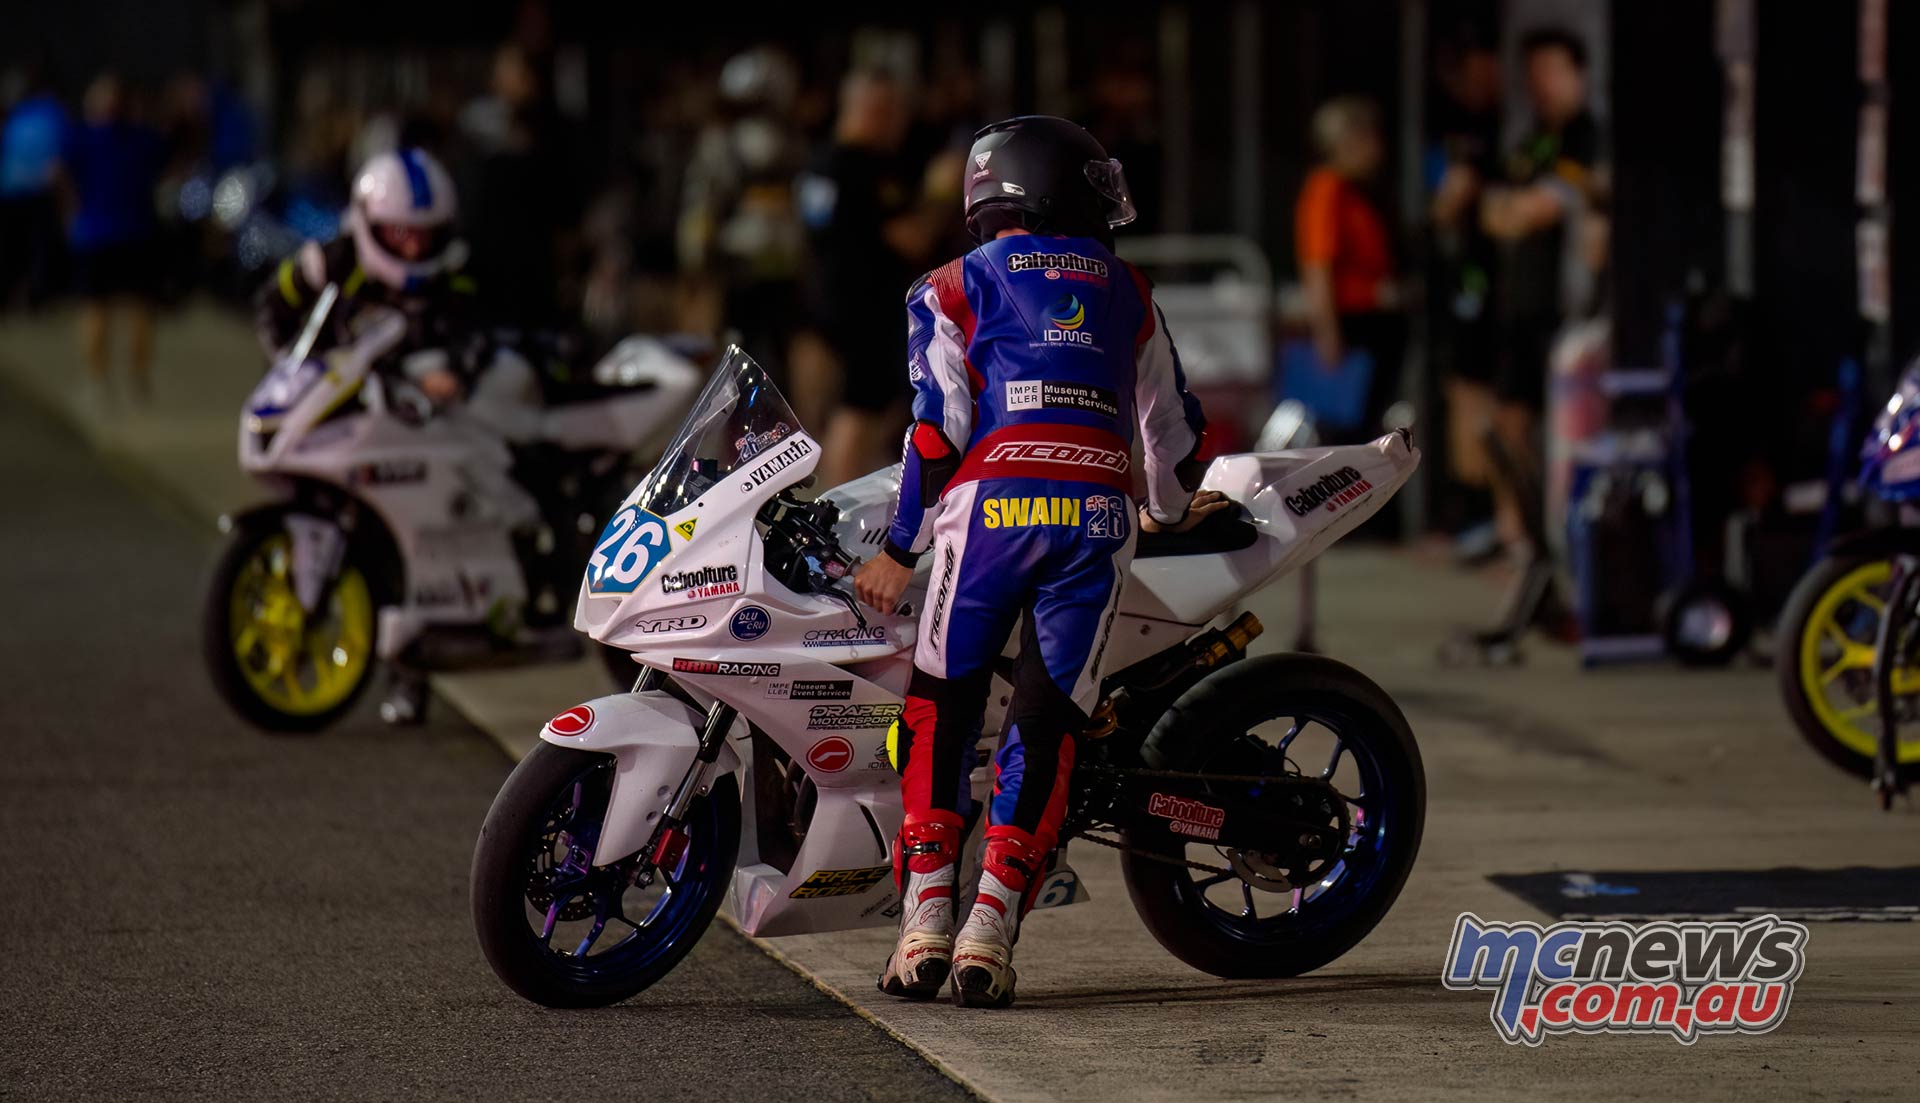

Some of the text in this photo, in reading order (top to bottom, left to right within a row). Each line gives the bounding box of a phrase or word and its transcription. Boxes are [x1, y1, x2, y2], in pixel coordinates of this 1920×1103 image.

[1008, 252, 1108, 278] Caboolture
[1043, 329, 1093, 345] IDMG
[1010, 385, 1038, 395] IMPE
[1044, 385, 1099, 399] Museum &
[1010, 395, 1038, 405] LLER
[1044, 394, 1118, 415] Event Services
[749, 439, 813, 486] YAMAHA
[1334, 480, 1373, 506] YAMAHA
[983, 494, 1125, 539] SWAIN 26
[587, 508, 664, 587] 26
[661, 565, 737, 593] Caboolture
[697, 582, 740, 598] YAMAHA
[636, 614, 707, 633] YRD
[809, 704, 904, 717] DRAPER
[809, 717, 897, 726] MOTORSPORT
[1180, 821, 1220, 840] YAMAHA
